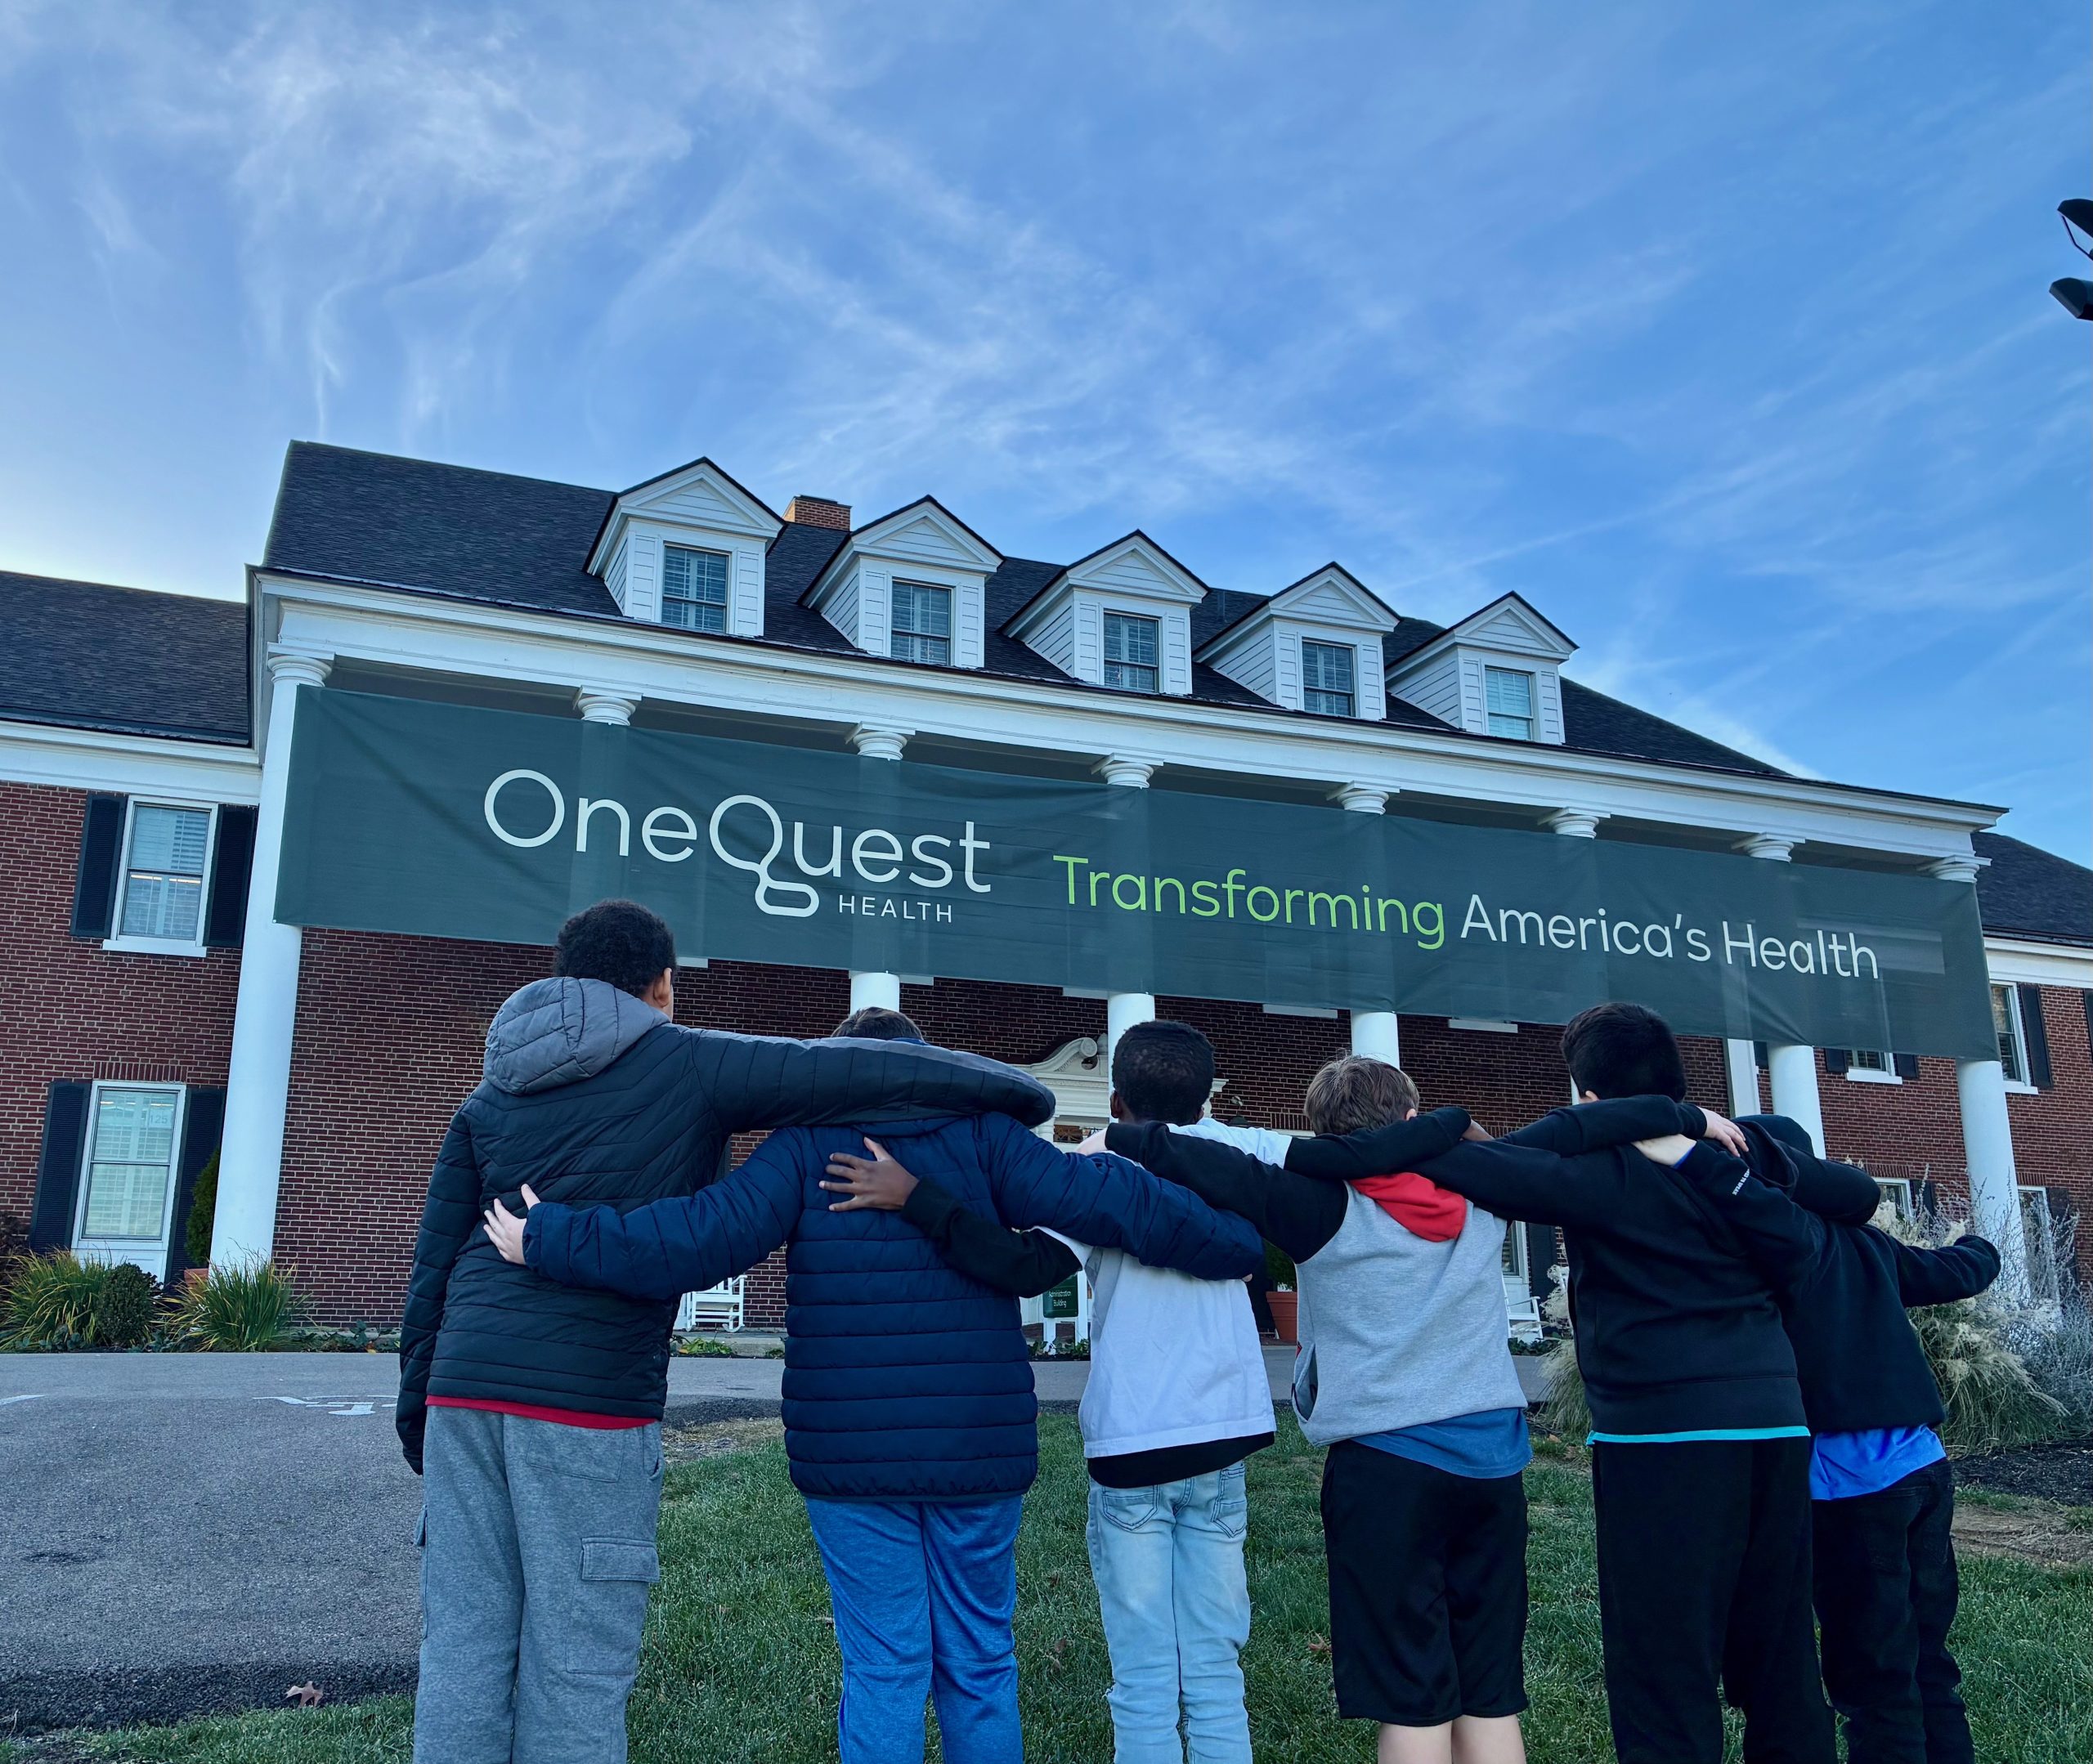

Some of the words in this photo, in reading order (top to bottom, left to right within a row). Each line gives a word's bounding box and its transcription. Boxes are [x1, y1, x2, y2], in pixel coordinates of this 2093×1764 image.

[484, 769, 992, 918] OneQuest
[838, 894, 952, 923] HEALTH
[1053, 854, 1445, 950] Transforming
[1460, 894, 1711, 961] America's
[1722, 920, 1879, 979] Health
